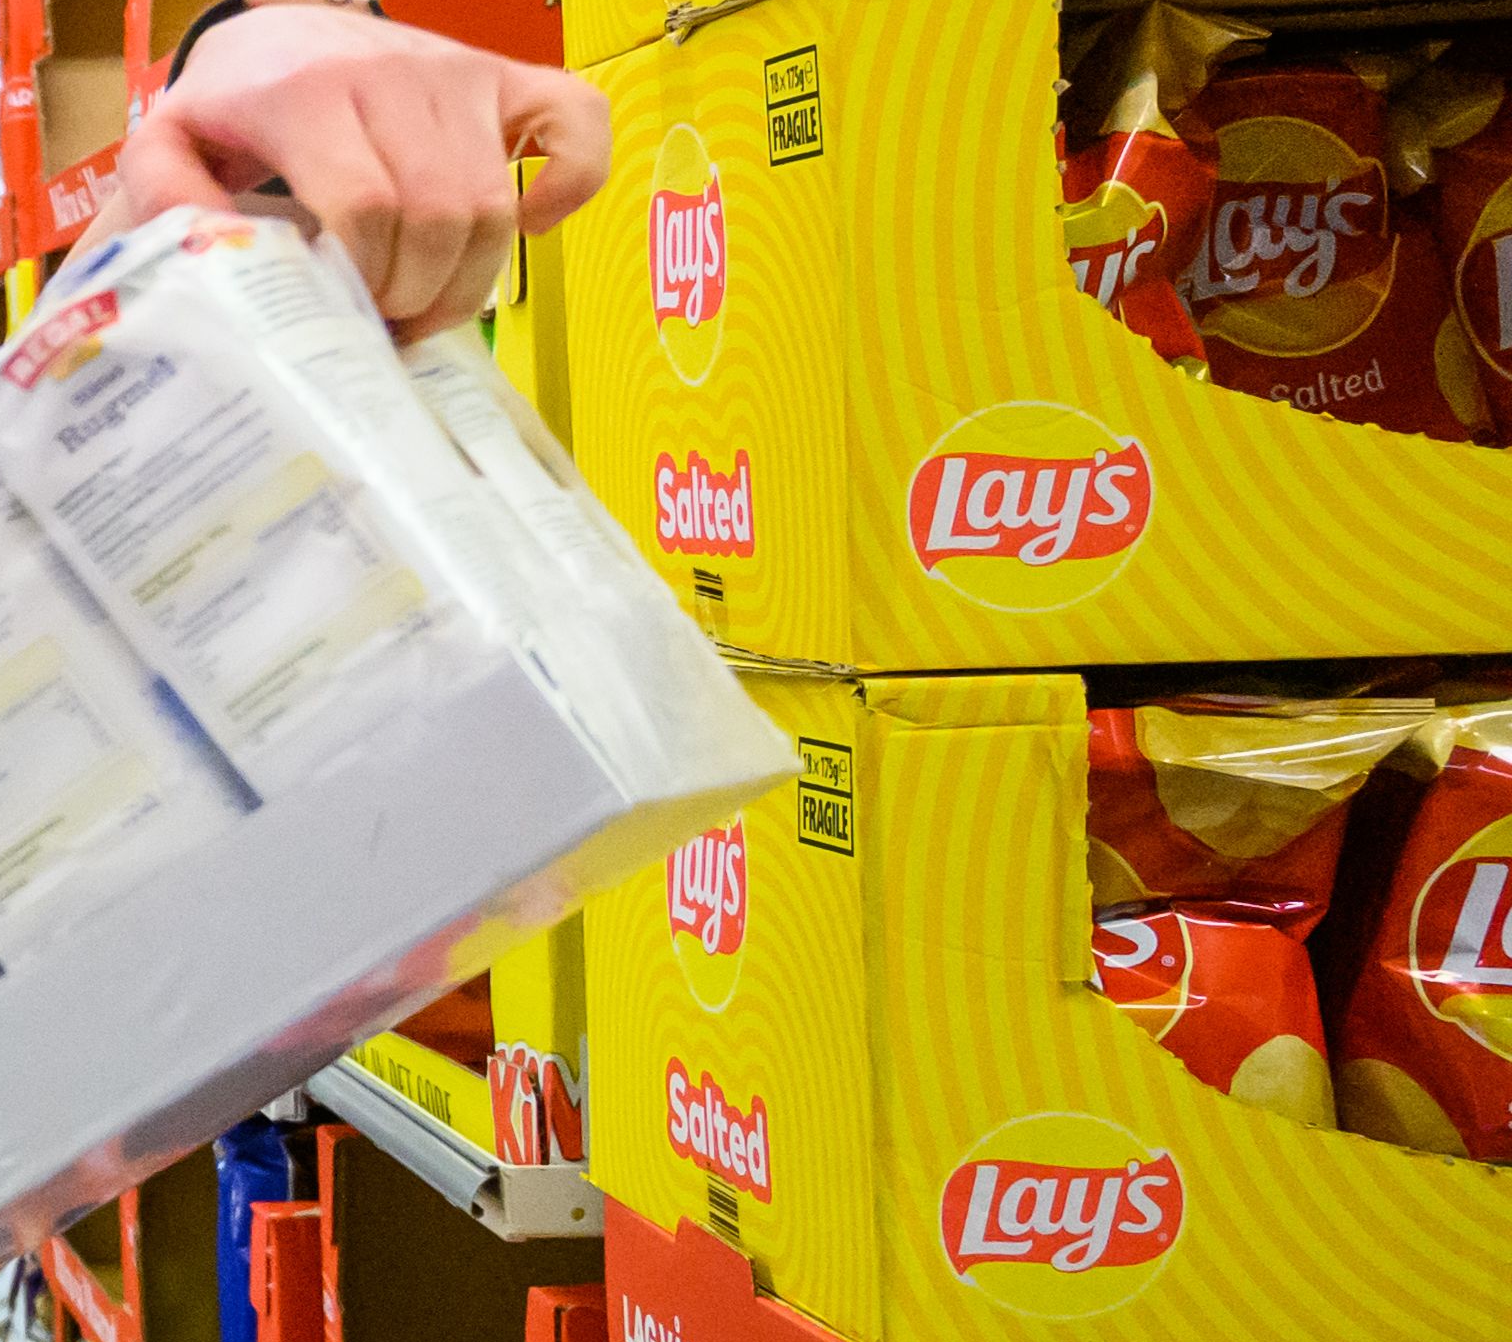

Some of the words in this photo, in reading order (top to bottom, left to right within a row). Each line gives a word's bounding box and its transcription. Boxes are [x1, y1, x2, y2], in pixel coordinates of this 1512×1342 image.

[772, 105, 818, 152] FRAGILE
[653, 184, 722, 327] Lay's
[659, 459, 752, 548] Salted
[929, 448, 1139, 565] Lay's
[803, 795, 849, 841] FRAGILE
[671, 822, 744, 956] Lay's
[417, 1074, 451, 1127] GODE
[670, 1071, 768, 1188] Salted
[959, 1159, 1170, 1273] Lay's
